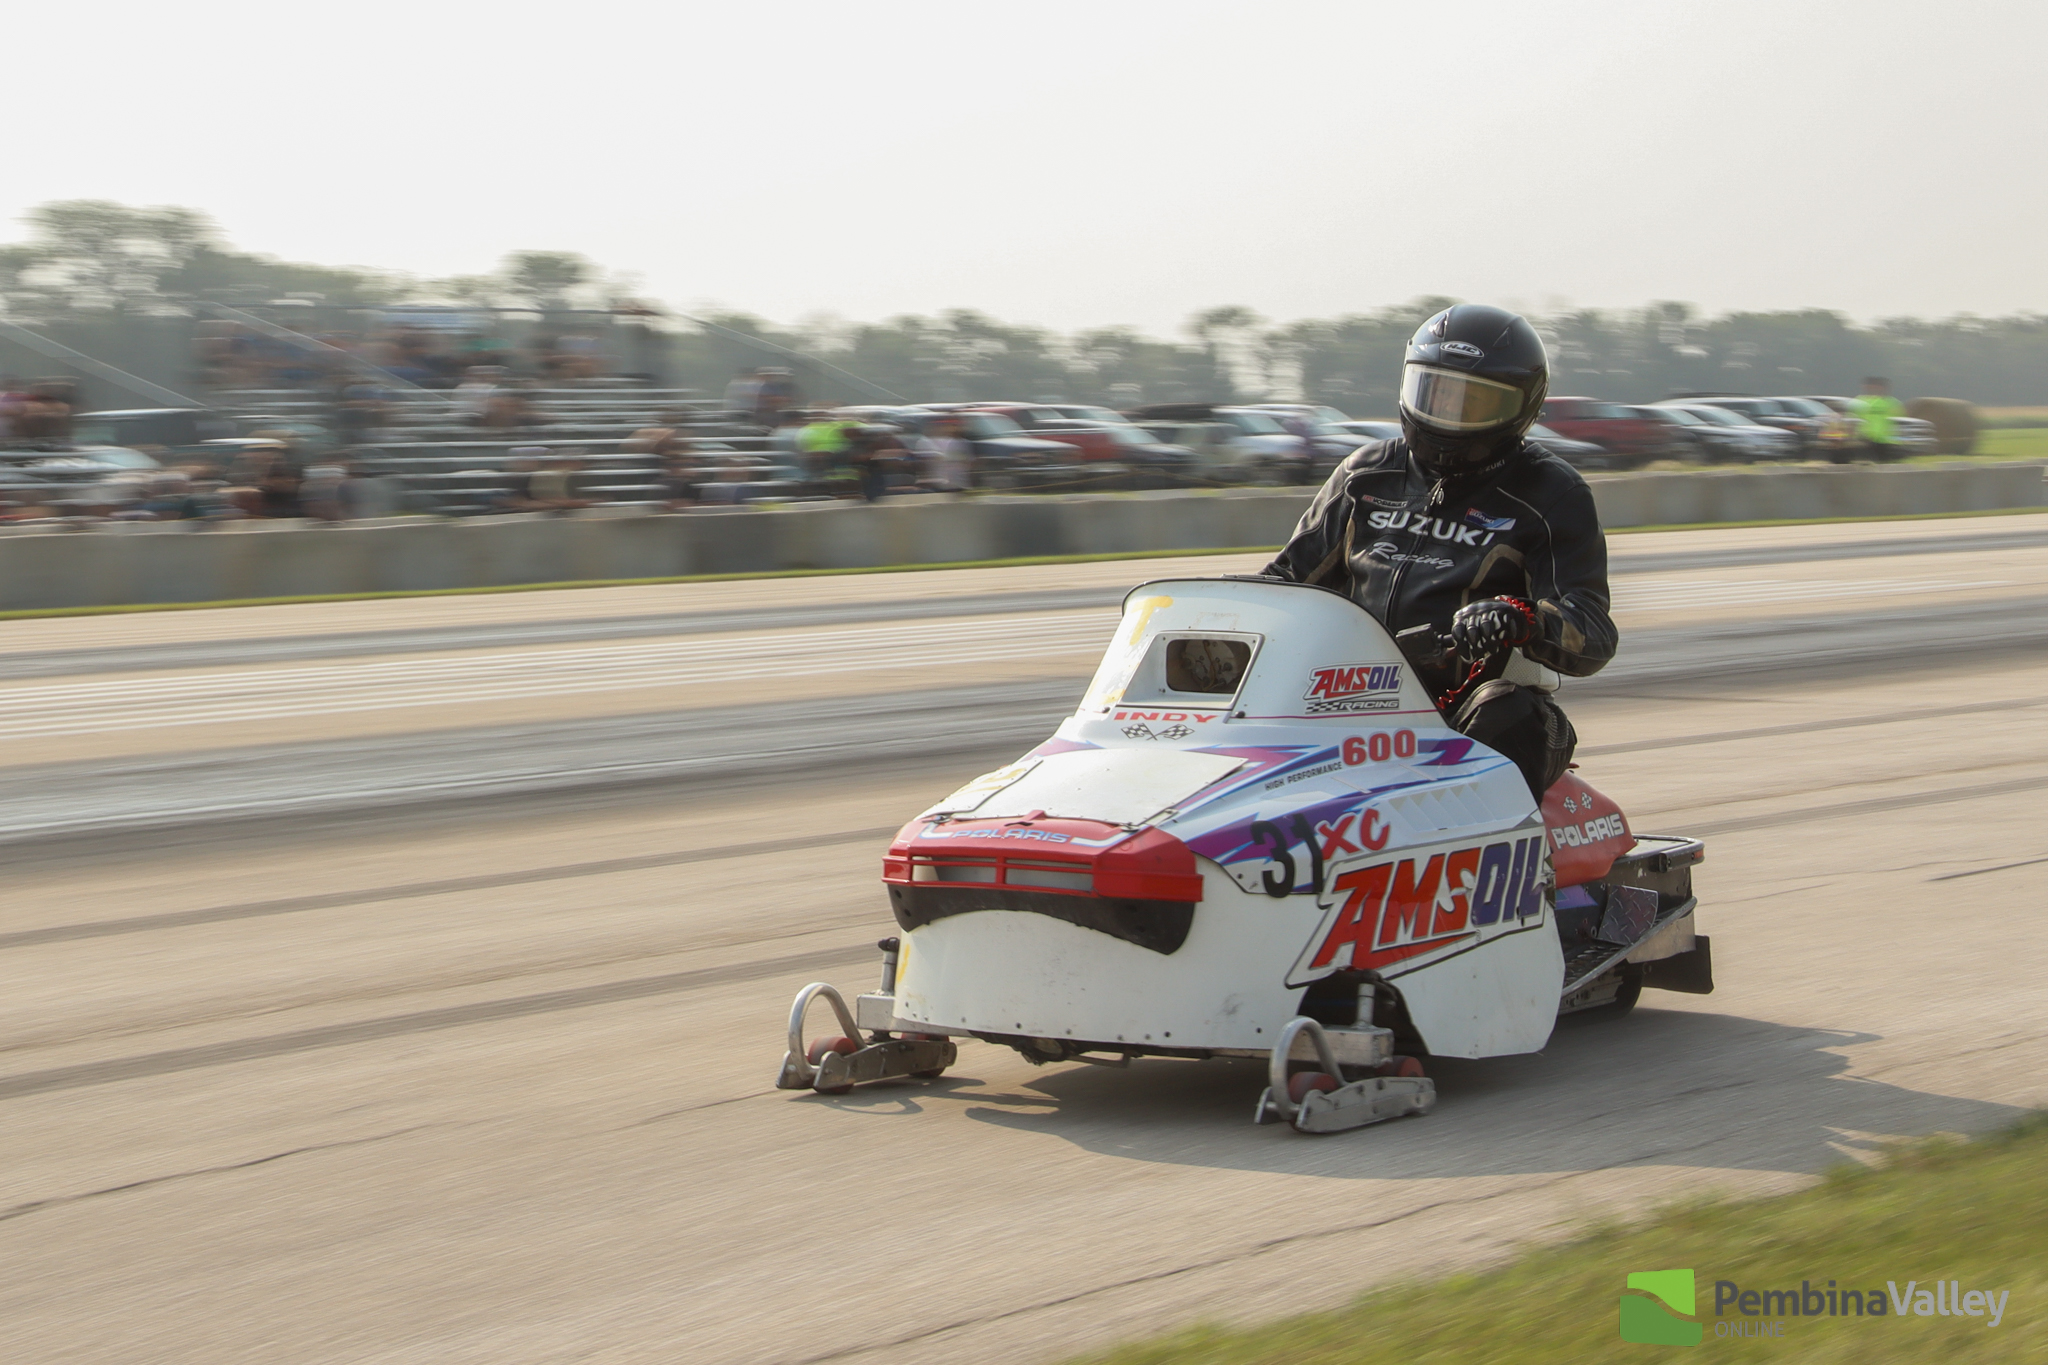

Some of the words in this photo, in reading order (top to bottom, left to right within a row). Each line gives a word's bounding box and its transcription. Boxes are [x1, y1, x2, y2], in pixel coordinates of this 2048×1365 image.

[1367, 510, 1495, 547] SUZUKI
[1368, 541, 1455, 569] Racing
[1310, 665, 1400, 700] AMSOIL
[1113, 711, 1219, 724] INDY
[1338, 700, 1399, 713] RACING
[1342, 728, 1417, 767] 600
[1264, 778, 1285, 791] HIGH
[1287, 761, 1343, 784] PERFORMANCE
[951, 828, 1071, 844] POLARIS
[1317, 807, 1391, 861] XC
[1551, 813, 1625, 849] POLARIS
[1309, 835, 1547, 971] AMSOIL
